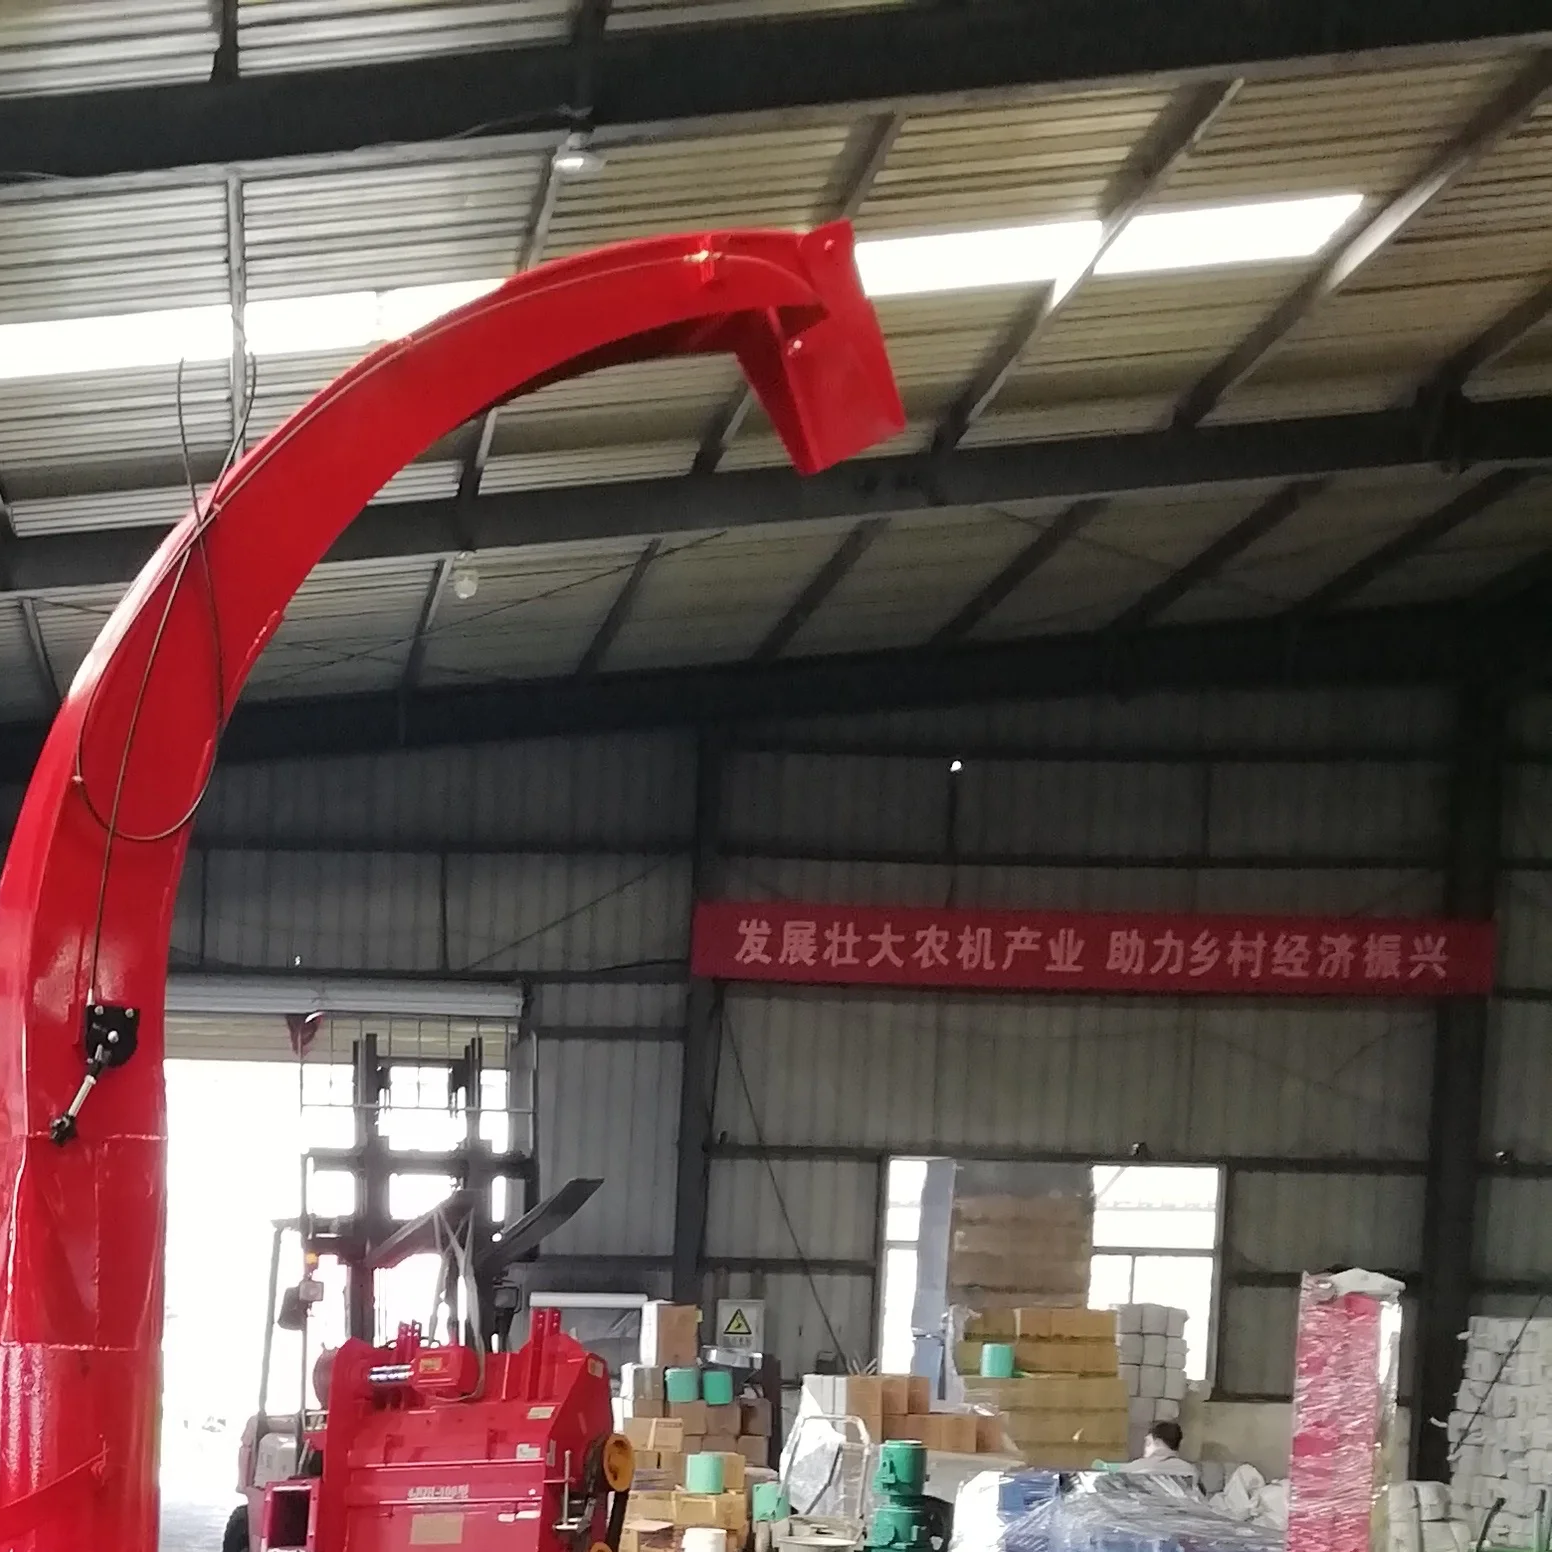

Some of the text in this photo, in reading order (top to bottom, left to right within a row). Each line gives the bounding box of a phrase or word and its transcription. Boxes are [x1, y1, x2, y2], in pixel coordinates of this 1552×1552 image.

[733, 918, 1449, 979] 发展壮大农机产业 助力乡村经济振兴
